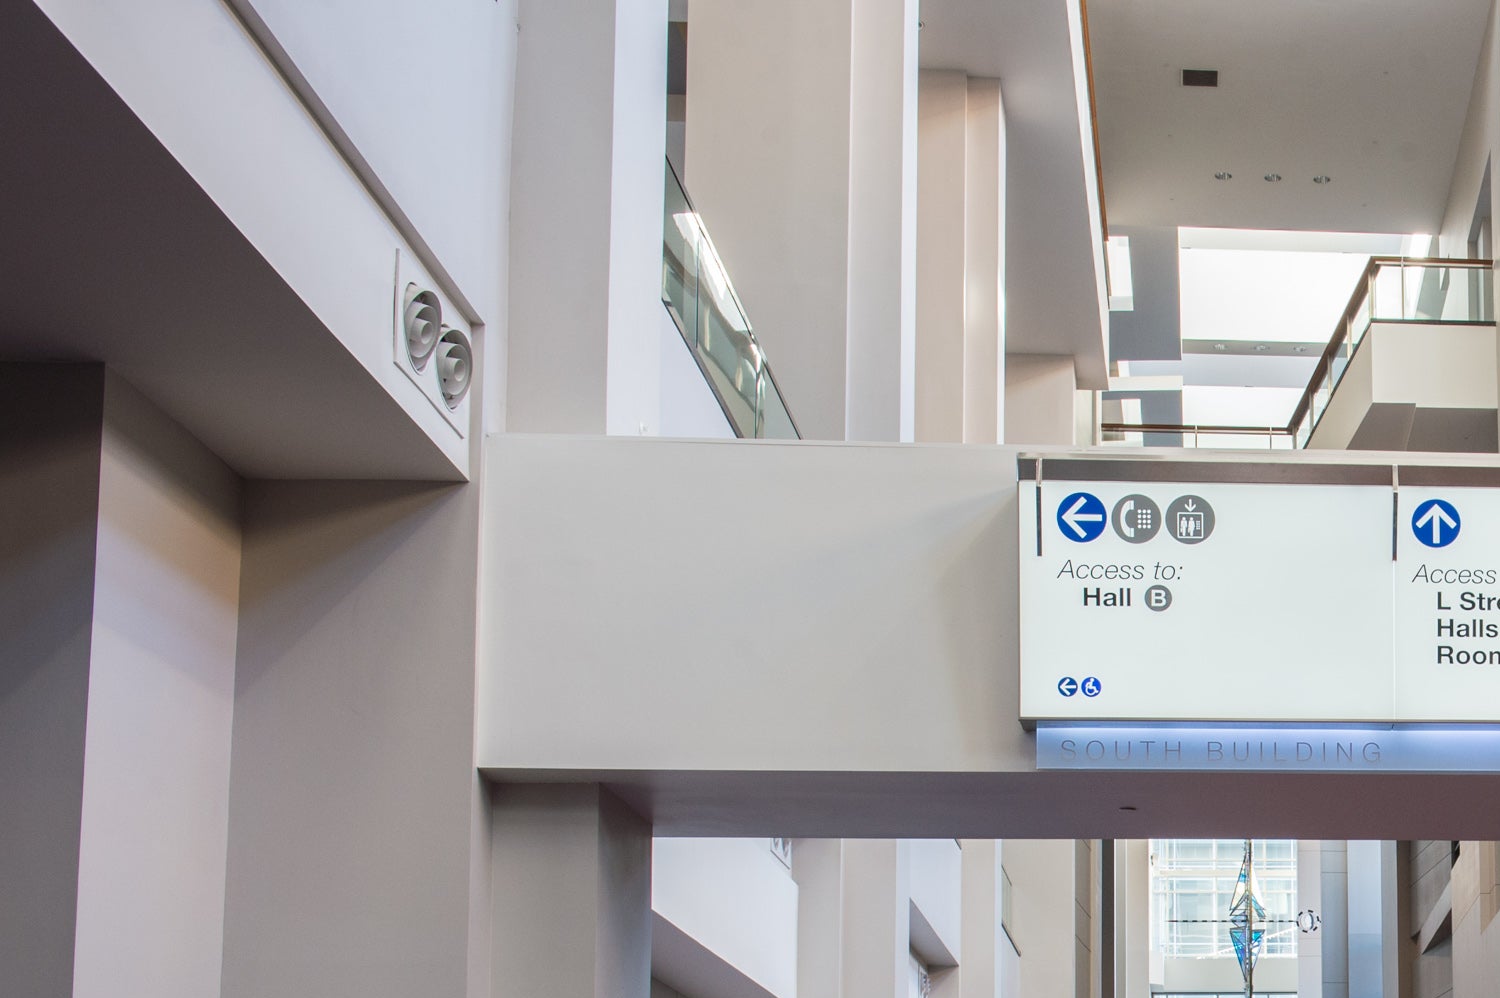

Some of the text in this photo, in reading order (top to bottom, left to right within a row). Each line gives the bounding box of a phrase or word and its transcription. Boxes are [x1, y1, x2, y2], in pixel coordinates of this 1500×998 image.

[1056, 559, 1183, 581] Access to:
[1411, 563, 1497, 585] Access
[1083, 587, 1168, 608] Hall B
[1436, 591, 1451, 611] L
[1436, 618, 1499, 638] Halls
[1060, 739, 1382, 763] SOUTH BUILDING
